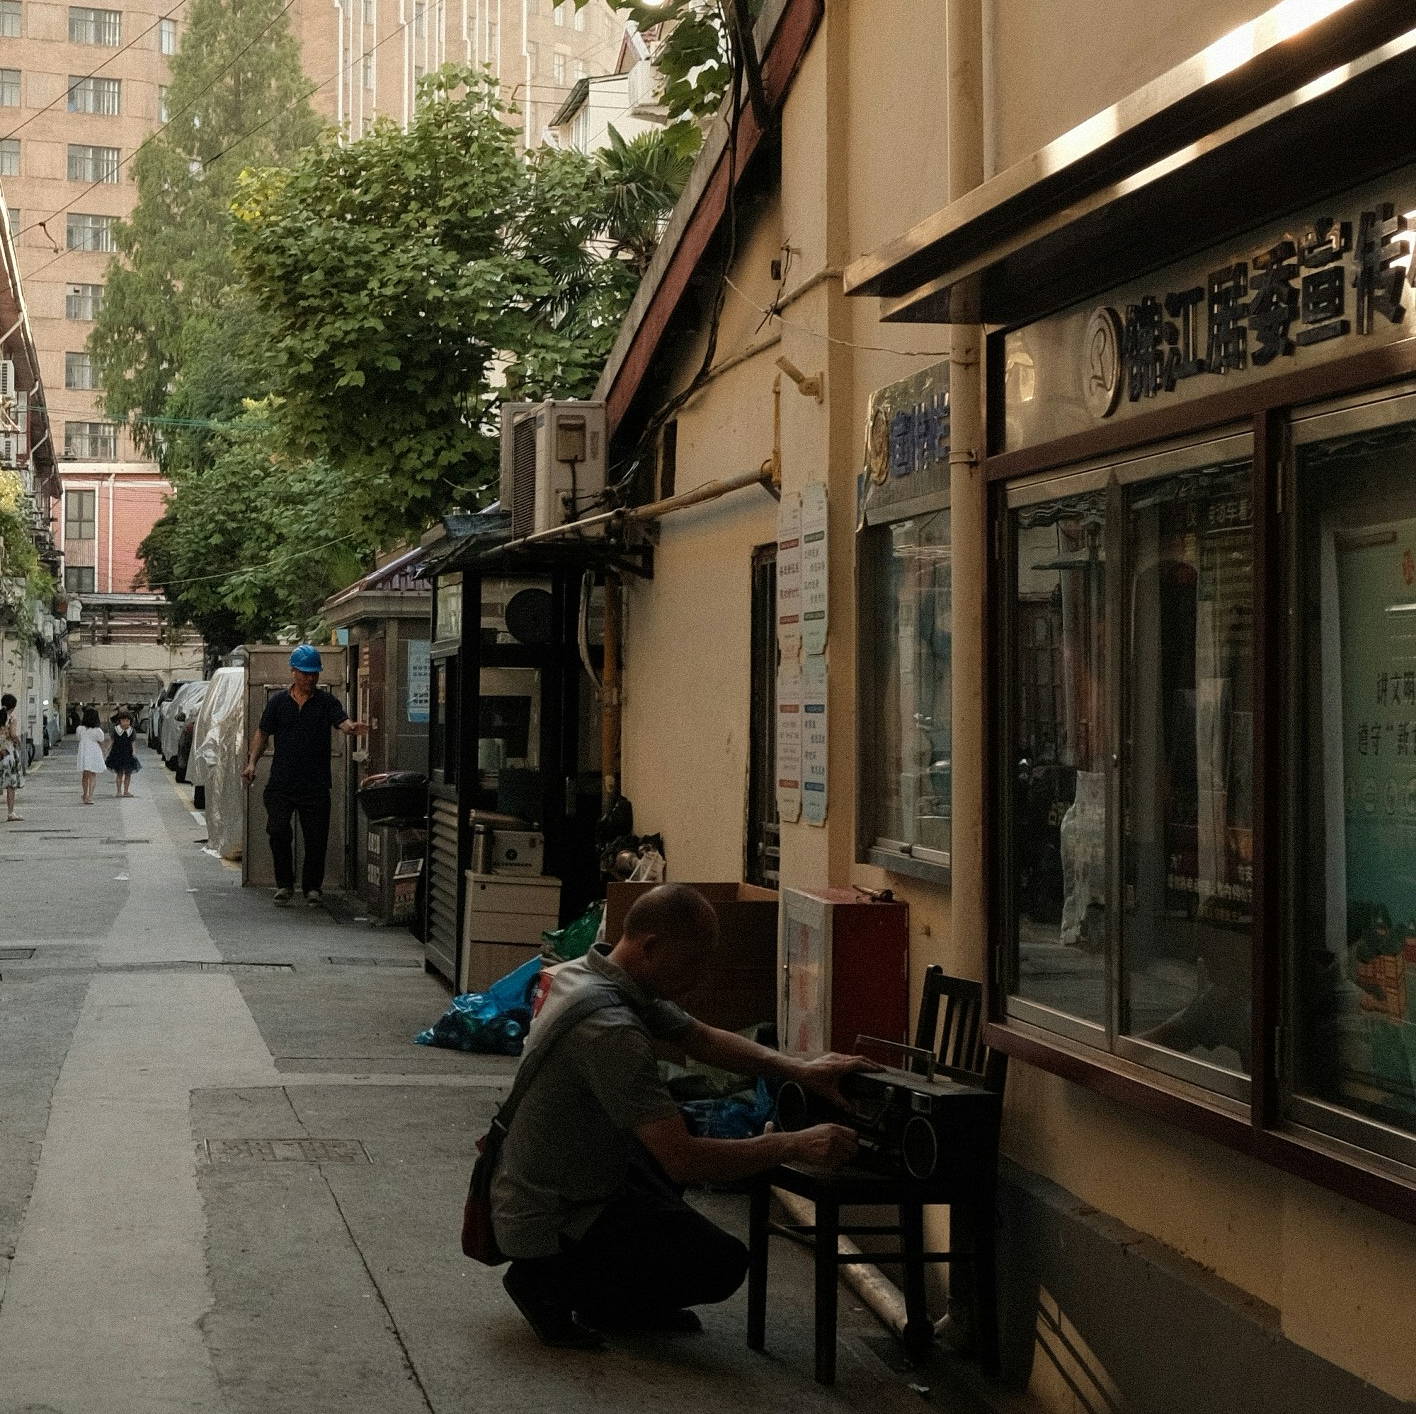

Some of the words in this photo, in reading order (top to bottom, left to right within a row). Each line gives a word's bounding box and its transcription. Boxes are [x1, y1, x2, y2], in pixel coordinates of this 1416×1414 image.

[1122, 201, 1416, 402] 锦江居委宣传
